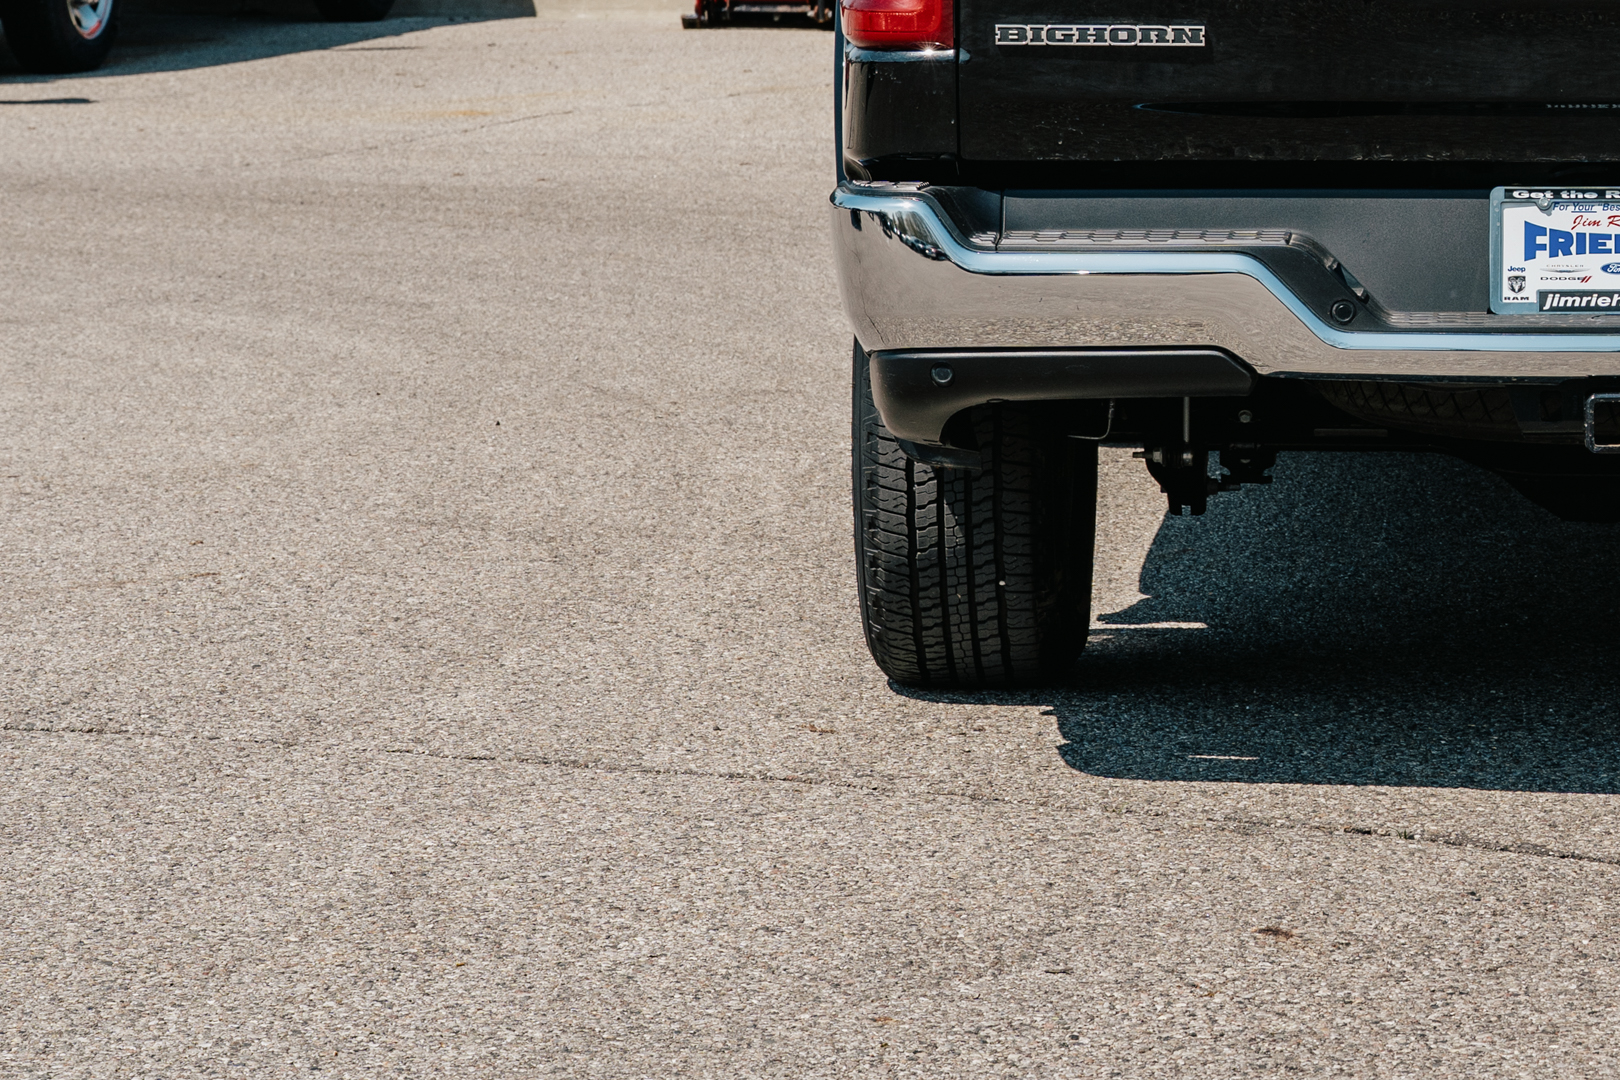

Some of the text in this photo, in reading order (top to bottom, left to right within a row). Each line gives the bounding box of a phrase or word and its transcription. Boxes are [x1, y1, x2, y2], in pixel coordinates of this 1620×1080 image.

[995, 24, 1205, 46] BIGHORN
[1512, 190, 1554, 199] Get
[1560, 190, 1599, 199] the
[1552, 202, 1569, 211] For
[1571, 202, 1597, 213] Your
[1571, 214, 1602, 231] Jim
[1507, 265, 1526, 273] Jeep
